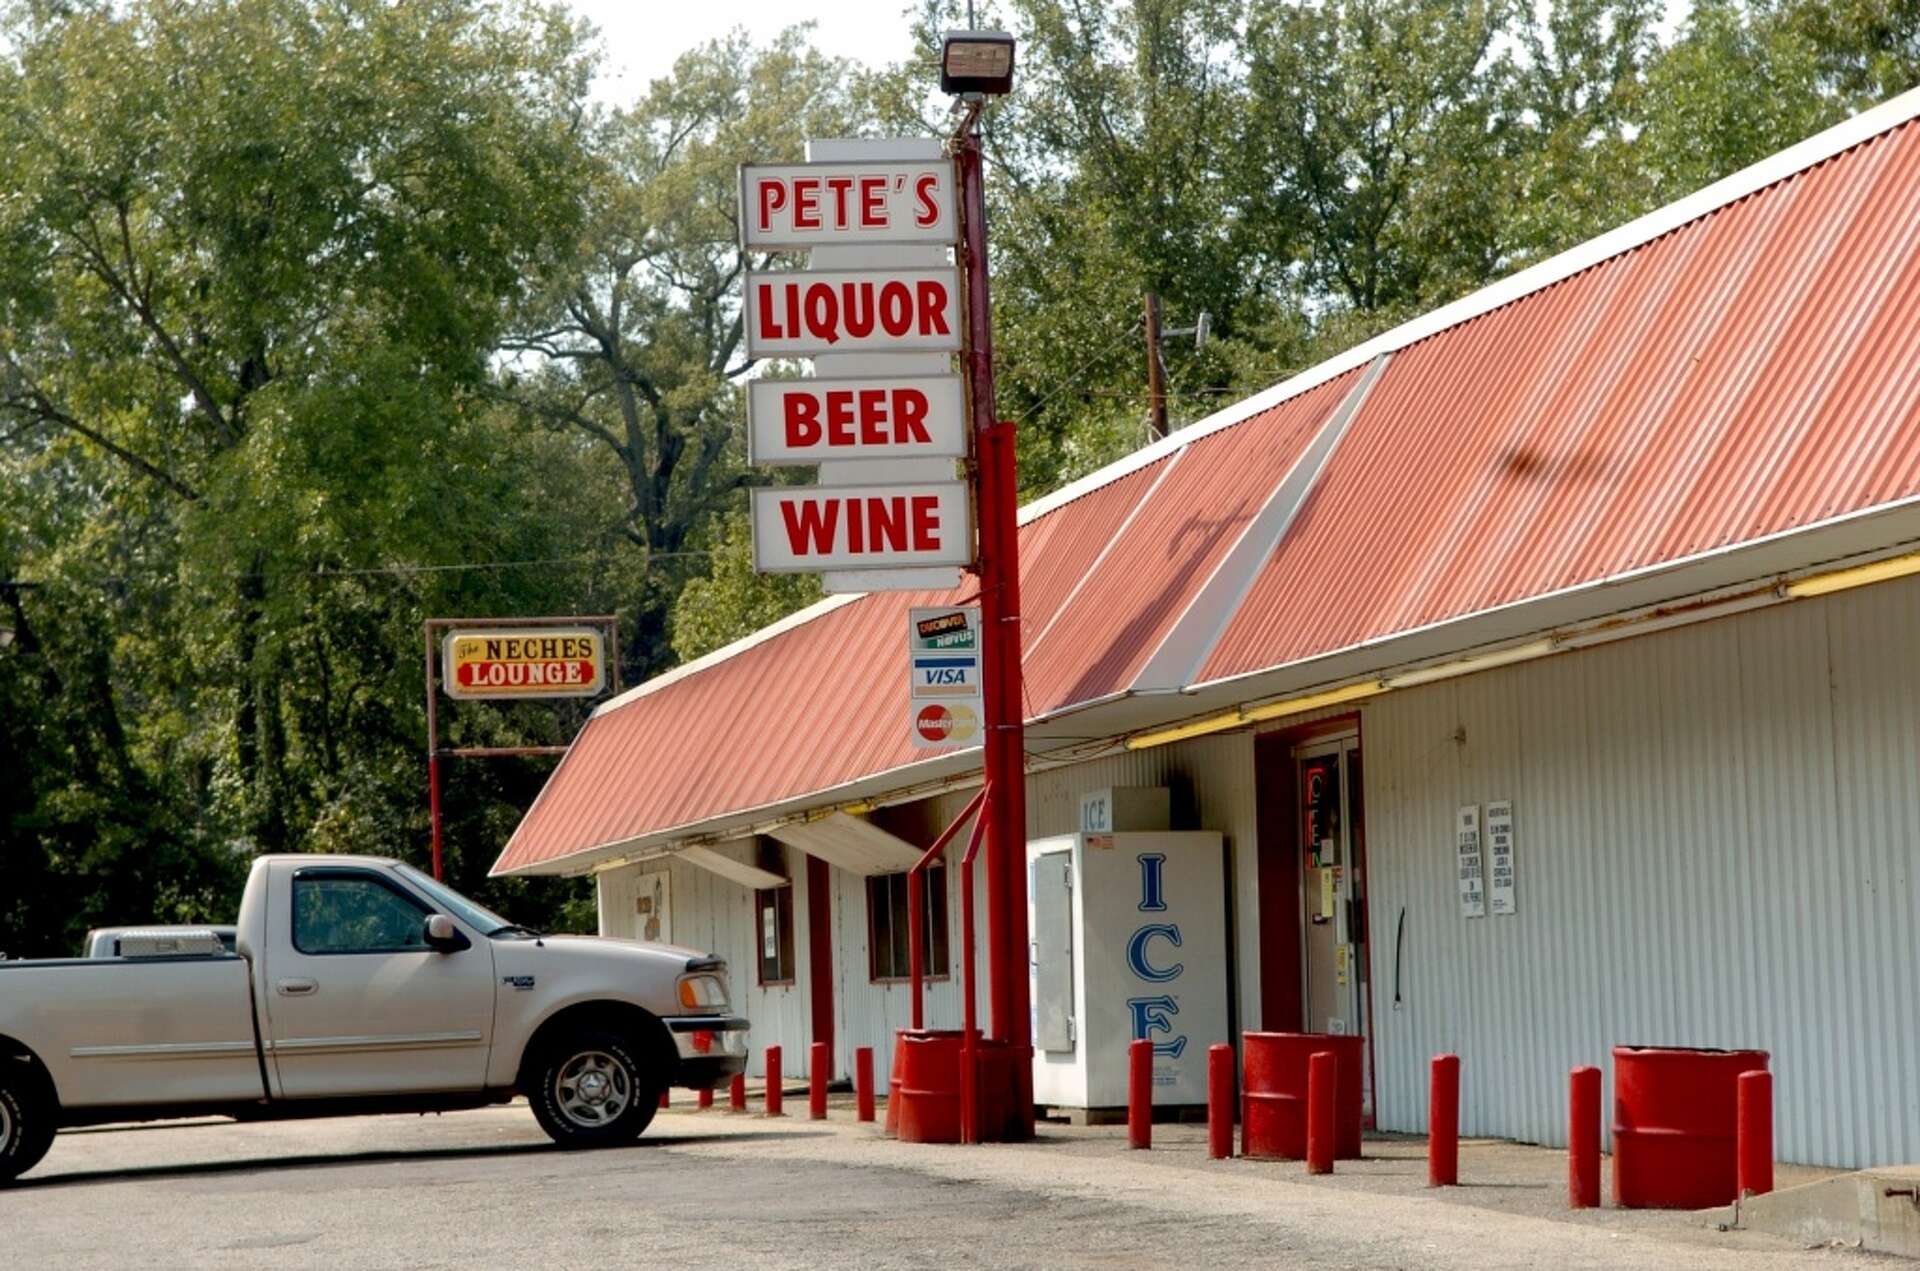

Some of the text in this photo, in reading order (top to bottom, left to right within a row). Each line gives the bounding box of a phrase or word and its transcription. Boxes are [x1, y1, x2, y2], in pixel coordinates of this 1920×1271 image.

[757, 172, 943, 232] PETE'S
[759, 280, 951, 344] LIQUOR
[783, 388, 933, 448] BEER
[780, 495, 942, 556] WINE
[471, 662, 582, 685] LOUNGE
[486, 638, 593, 660] NECHES
[925, 668, 966, 685] VISA
[1084, 801, 1106, 832] ICE
[1126, 852, 1187, 1060] ICE
